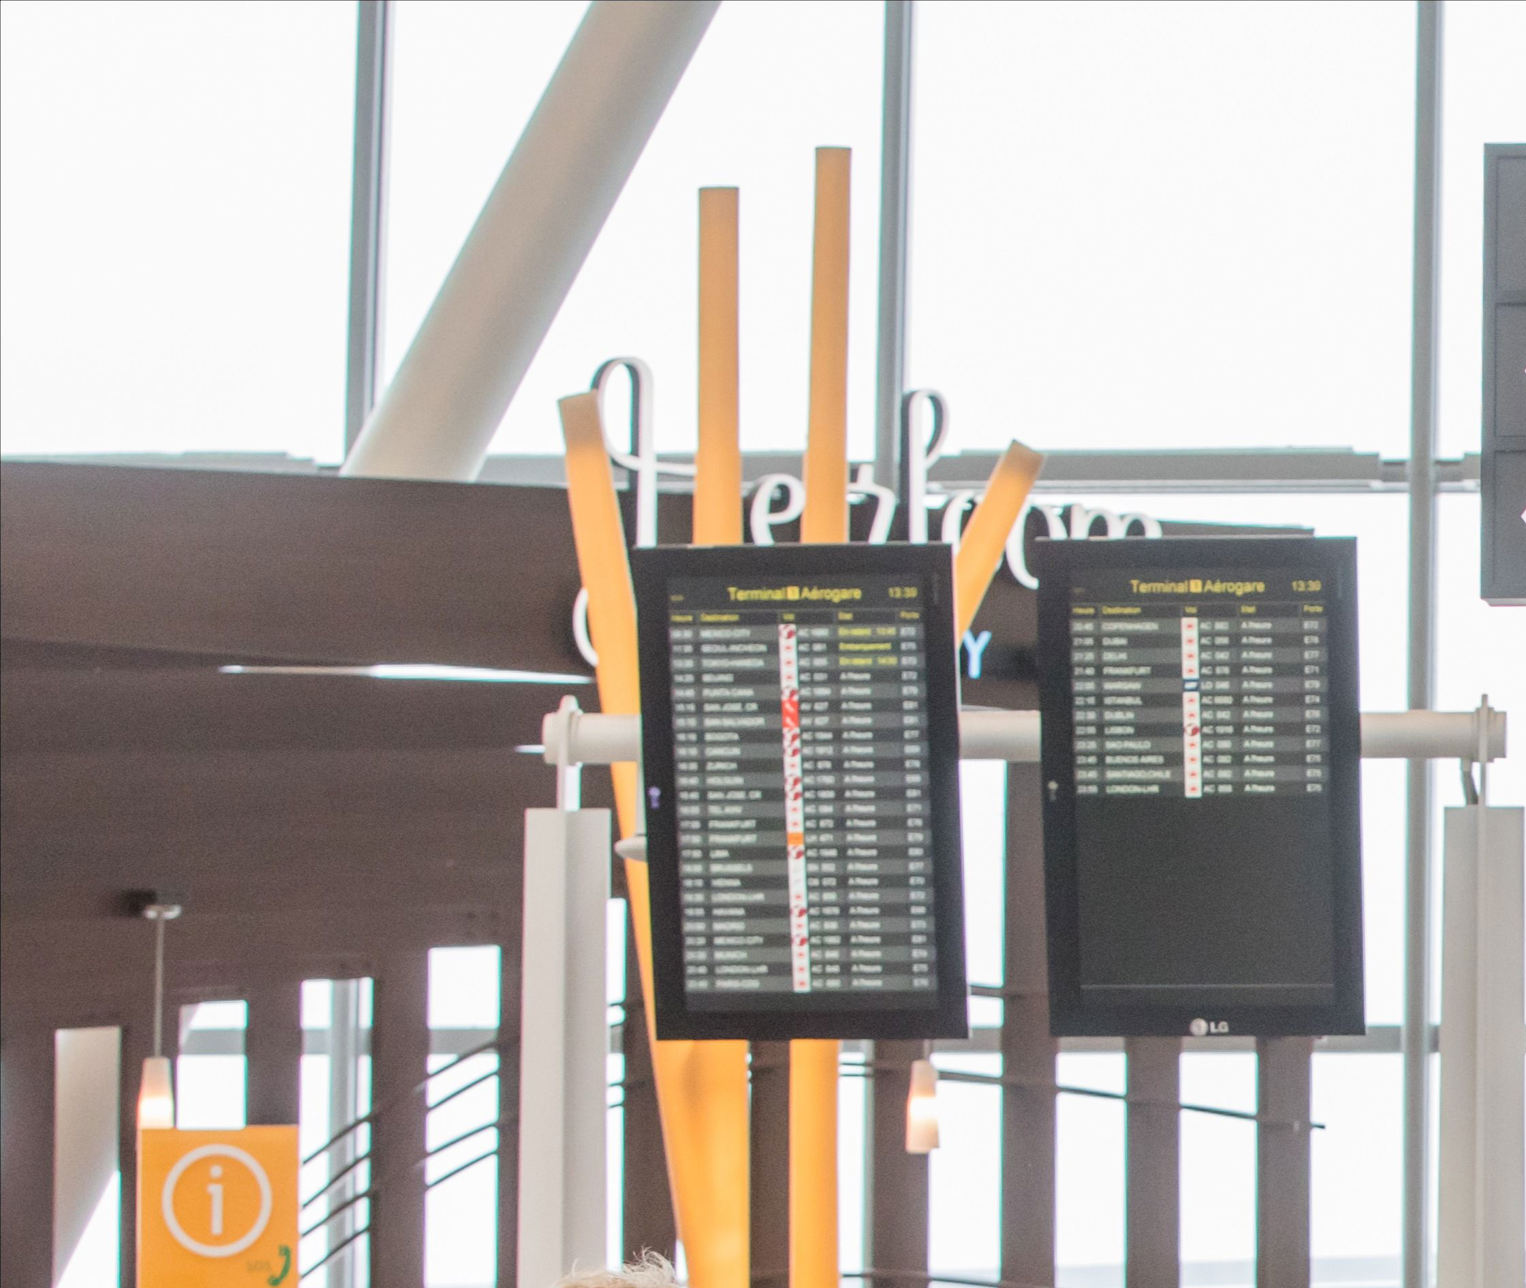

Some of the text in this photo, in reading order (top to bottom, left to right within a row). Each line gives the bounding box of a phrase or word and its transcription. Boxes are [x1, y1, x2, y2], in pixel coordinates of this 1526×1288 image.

[727, 587, 786, 600] Terminal
[801, 587, 861, 603] Aérogare
[1131, 580, 1188, 593] Terminal
[1204, 580, 1265, 596] Aérogare
[1210, 1021, 1229, 1033] LG
